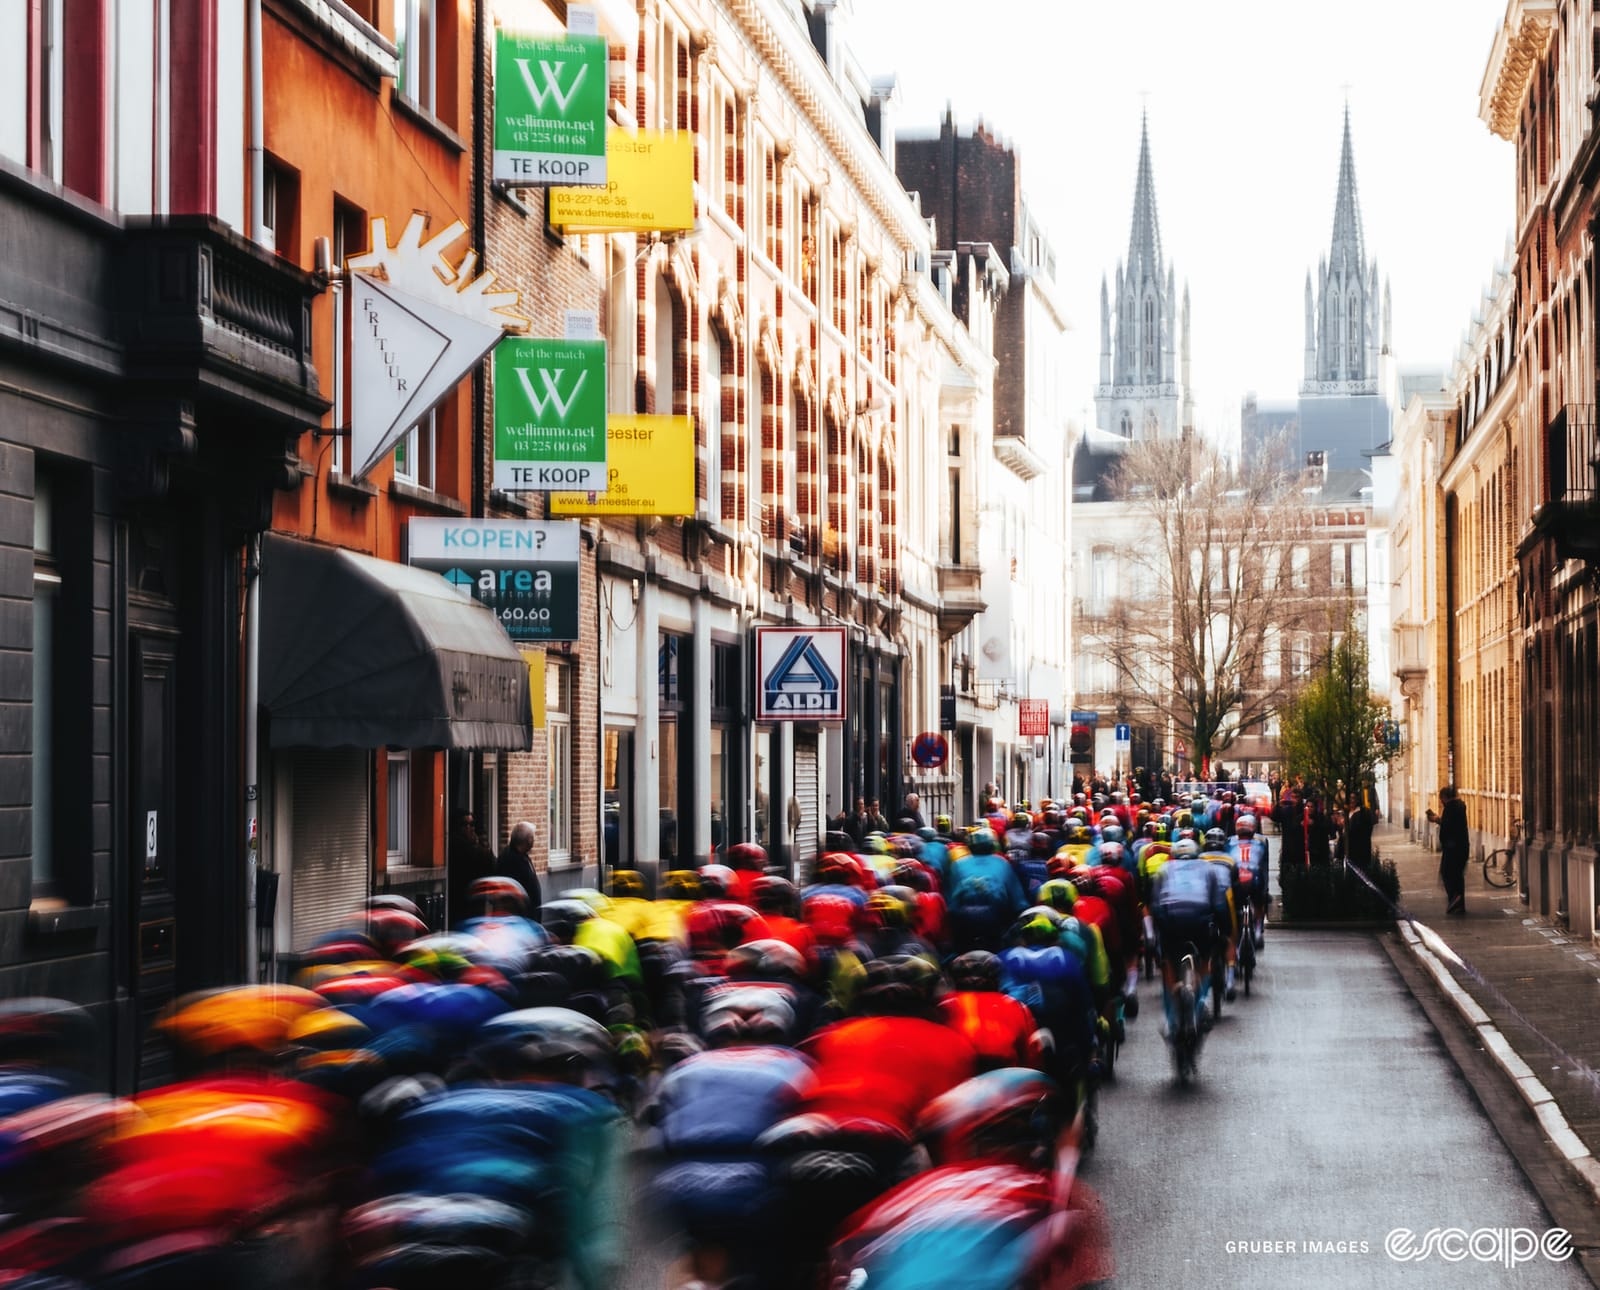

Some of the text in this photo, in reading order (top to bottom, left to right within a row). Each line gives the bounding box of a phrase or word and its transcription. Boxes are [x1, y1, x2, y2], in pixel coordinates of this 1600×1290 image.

[556, 43, 586, 54] match
[513, 58, 588, 111] W
[505, 114, 595, 132] wellimmo.net
[513, 131, 587, 145] 03 225 00 68
[510, 157, 590, 176] TE KOOP
[557, 207, 655, 220] www.demeester.eu
[363, 298, 408, 391] FRITUUR
[515, 348, 585, 360] feel the match
[513, 367, 588, 419] W
[505, 423, 595, 438] wellimmo.net
[607, 428, 654, 440] eester
[514, 440, 587, 453] 03 225 00 68
[511, 467, 533, 482] TE
[539, 468, 590, 484] KOOP
[443, 527, 547, 549] KOPEN?
[478, 568, 553, 591] area
[480, 590, 552, 599] partners
[772, 693, 832, 709] ALDI
[149, 817, 156, 851] 3
